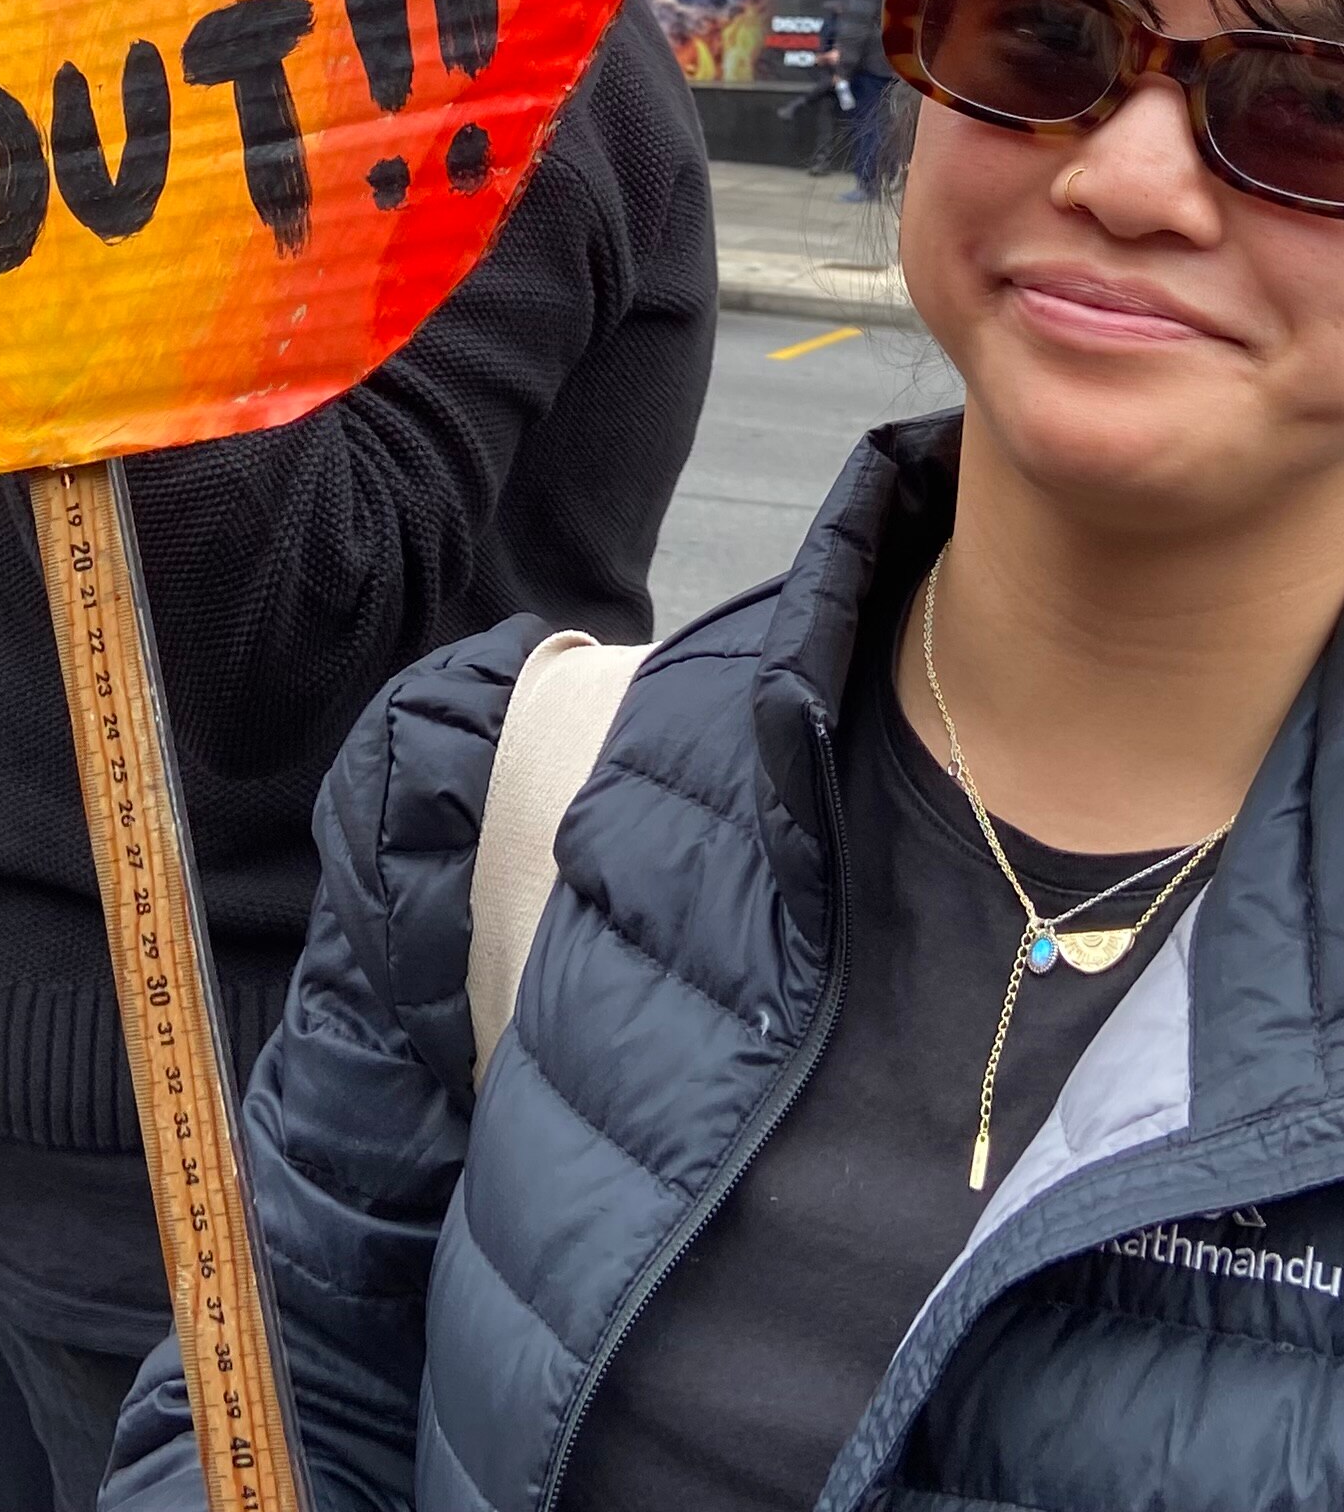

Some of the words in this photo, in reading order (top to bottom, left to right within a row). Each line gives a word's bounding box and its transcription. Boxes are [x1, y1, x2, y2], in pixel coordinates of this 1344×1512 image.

[65, 501, 83, 527] 19
[70, 540, 94, 573] 20
[80, 584, 97, 610] 21
[87, 627, 105, 655] 22
[95, 669, 113, 698] 23
[103, 713, 120, 741] 24
[111, 757, 128, 784] 25
[118, 799, 136, 828] 26
[126, 843, 144, 870] 27
[134, 888, 152, 916] 28
[141, 931, 160, 960] 29
[146, 974, 171, 1008] 30
[157, 1021, 175, 1047] 31
[165, 1066, 184, 1095] 32
[173, 1111, 192, 1139] 33
[181, 1157, 200, 1186] 34
[190, 1202, 208, 1232] 35
[197, 1249, 216, 1279] 36
[206, 1295, 226, 1325] 37
[214, 1342, 233, 1373] 38
[222, 1389, 242, 1419] 39
[230, 1436, 255, 1469] 40
[241, 1485, 259, 1511] 41
